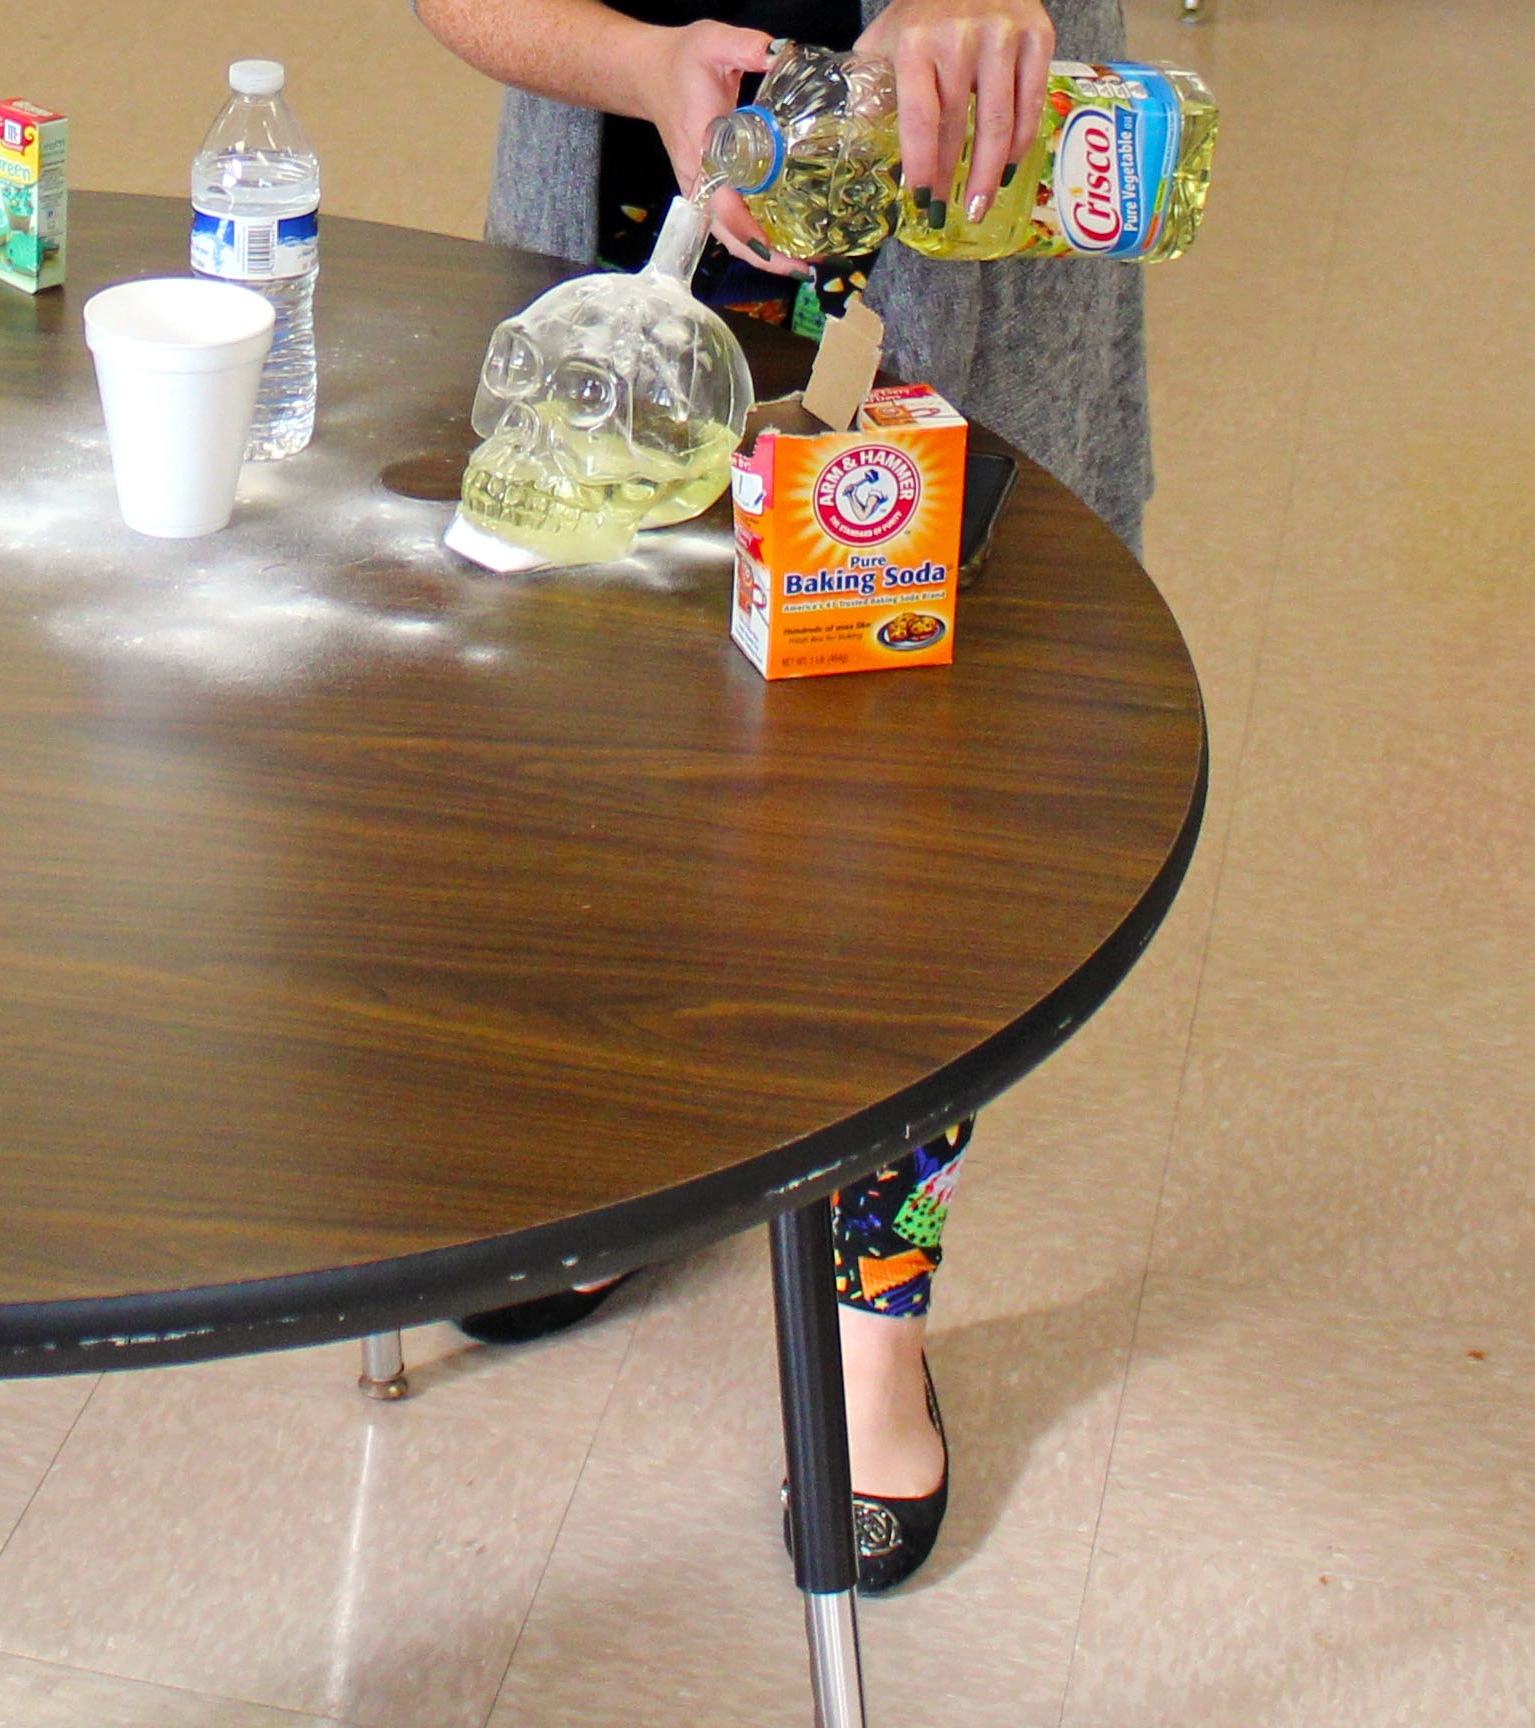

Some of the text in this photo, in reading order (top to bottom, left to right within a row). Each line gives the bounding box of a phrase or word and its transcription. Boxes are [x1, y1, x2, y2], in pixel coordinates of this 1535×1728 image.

[1118, 130, 1138, 201] Vegetable
[1073, 127, 1121, 242] Crisco
[1123, 200, 1138, 232] Pure
[819, 449, 915, 507] ARM & HAMMER
[838, 525, 874, 538] STANDARD
[873, 525, 883, 536] OF
[881, 510, 903, 532] PURITY
[785, 561, 946, 595] Baking Soda
[850, 555, 887, 568] Pure
